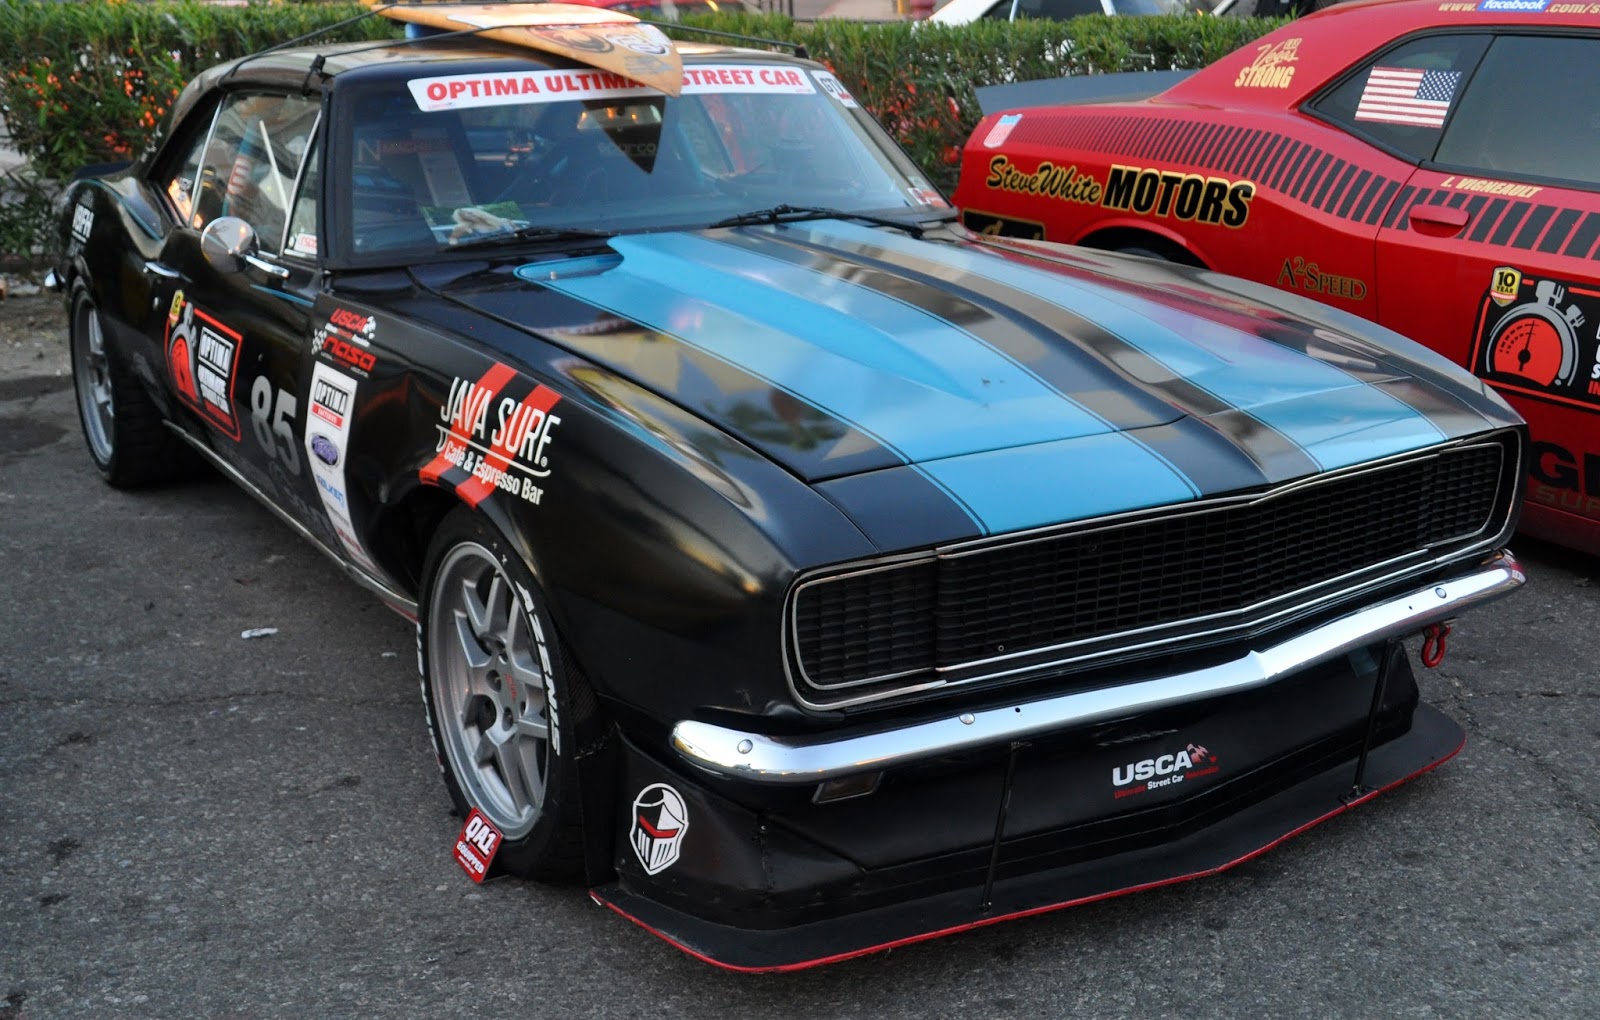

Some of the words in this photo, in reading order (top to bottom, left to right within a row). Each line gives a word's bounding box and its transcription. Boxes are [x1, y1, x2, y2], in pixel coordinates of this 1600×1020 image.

[426, 77, 540, 101] OPTIMA
[544, 71, 647, 93] ULTIMA
[759, 69, 804, 86] CAR
[1234, 65, 1296, 89] STRONG
[1101, 164, 1256, 229] MOTORS
[1455, 178, 1543, 198] VIGNEAULT
[1496, 285, 1514, 294] YEAR
[1498, 271, 1516, 287] 10
[201, 331, 230, 373] OPTIMA
[314, 379, 348, 415] OPTIMA
[251, 375, 300, 476] 85
[441, 376, 493, 440] JAVA
[491, 397, 561, 464] SURF
[463, 451, 475, 472] &
[472, 455, 520, 495] Espresso
[521, 477, 544, 505] Bar
[1112, 750, 1193, 786] USCA
[1147, 777, 1171, 789] Street
[1172, 775, 1184, 783] Car
[465, 816, 497, 856] QA1
